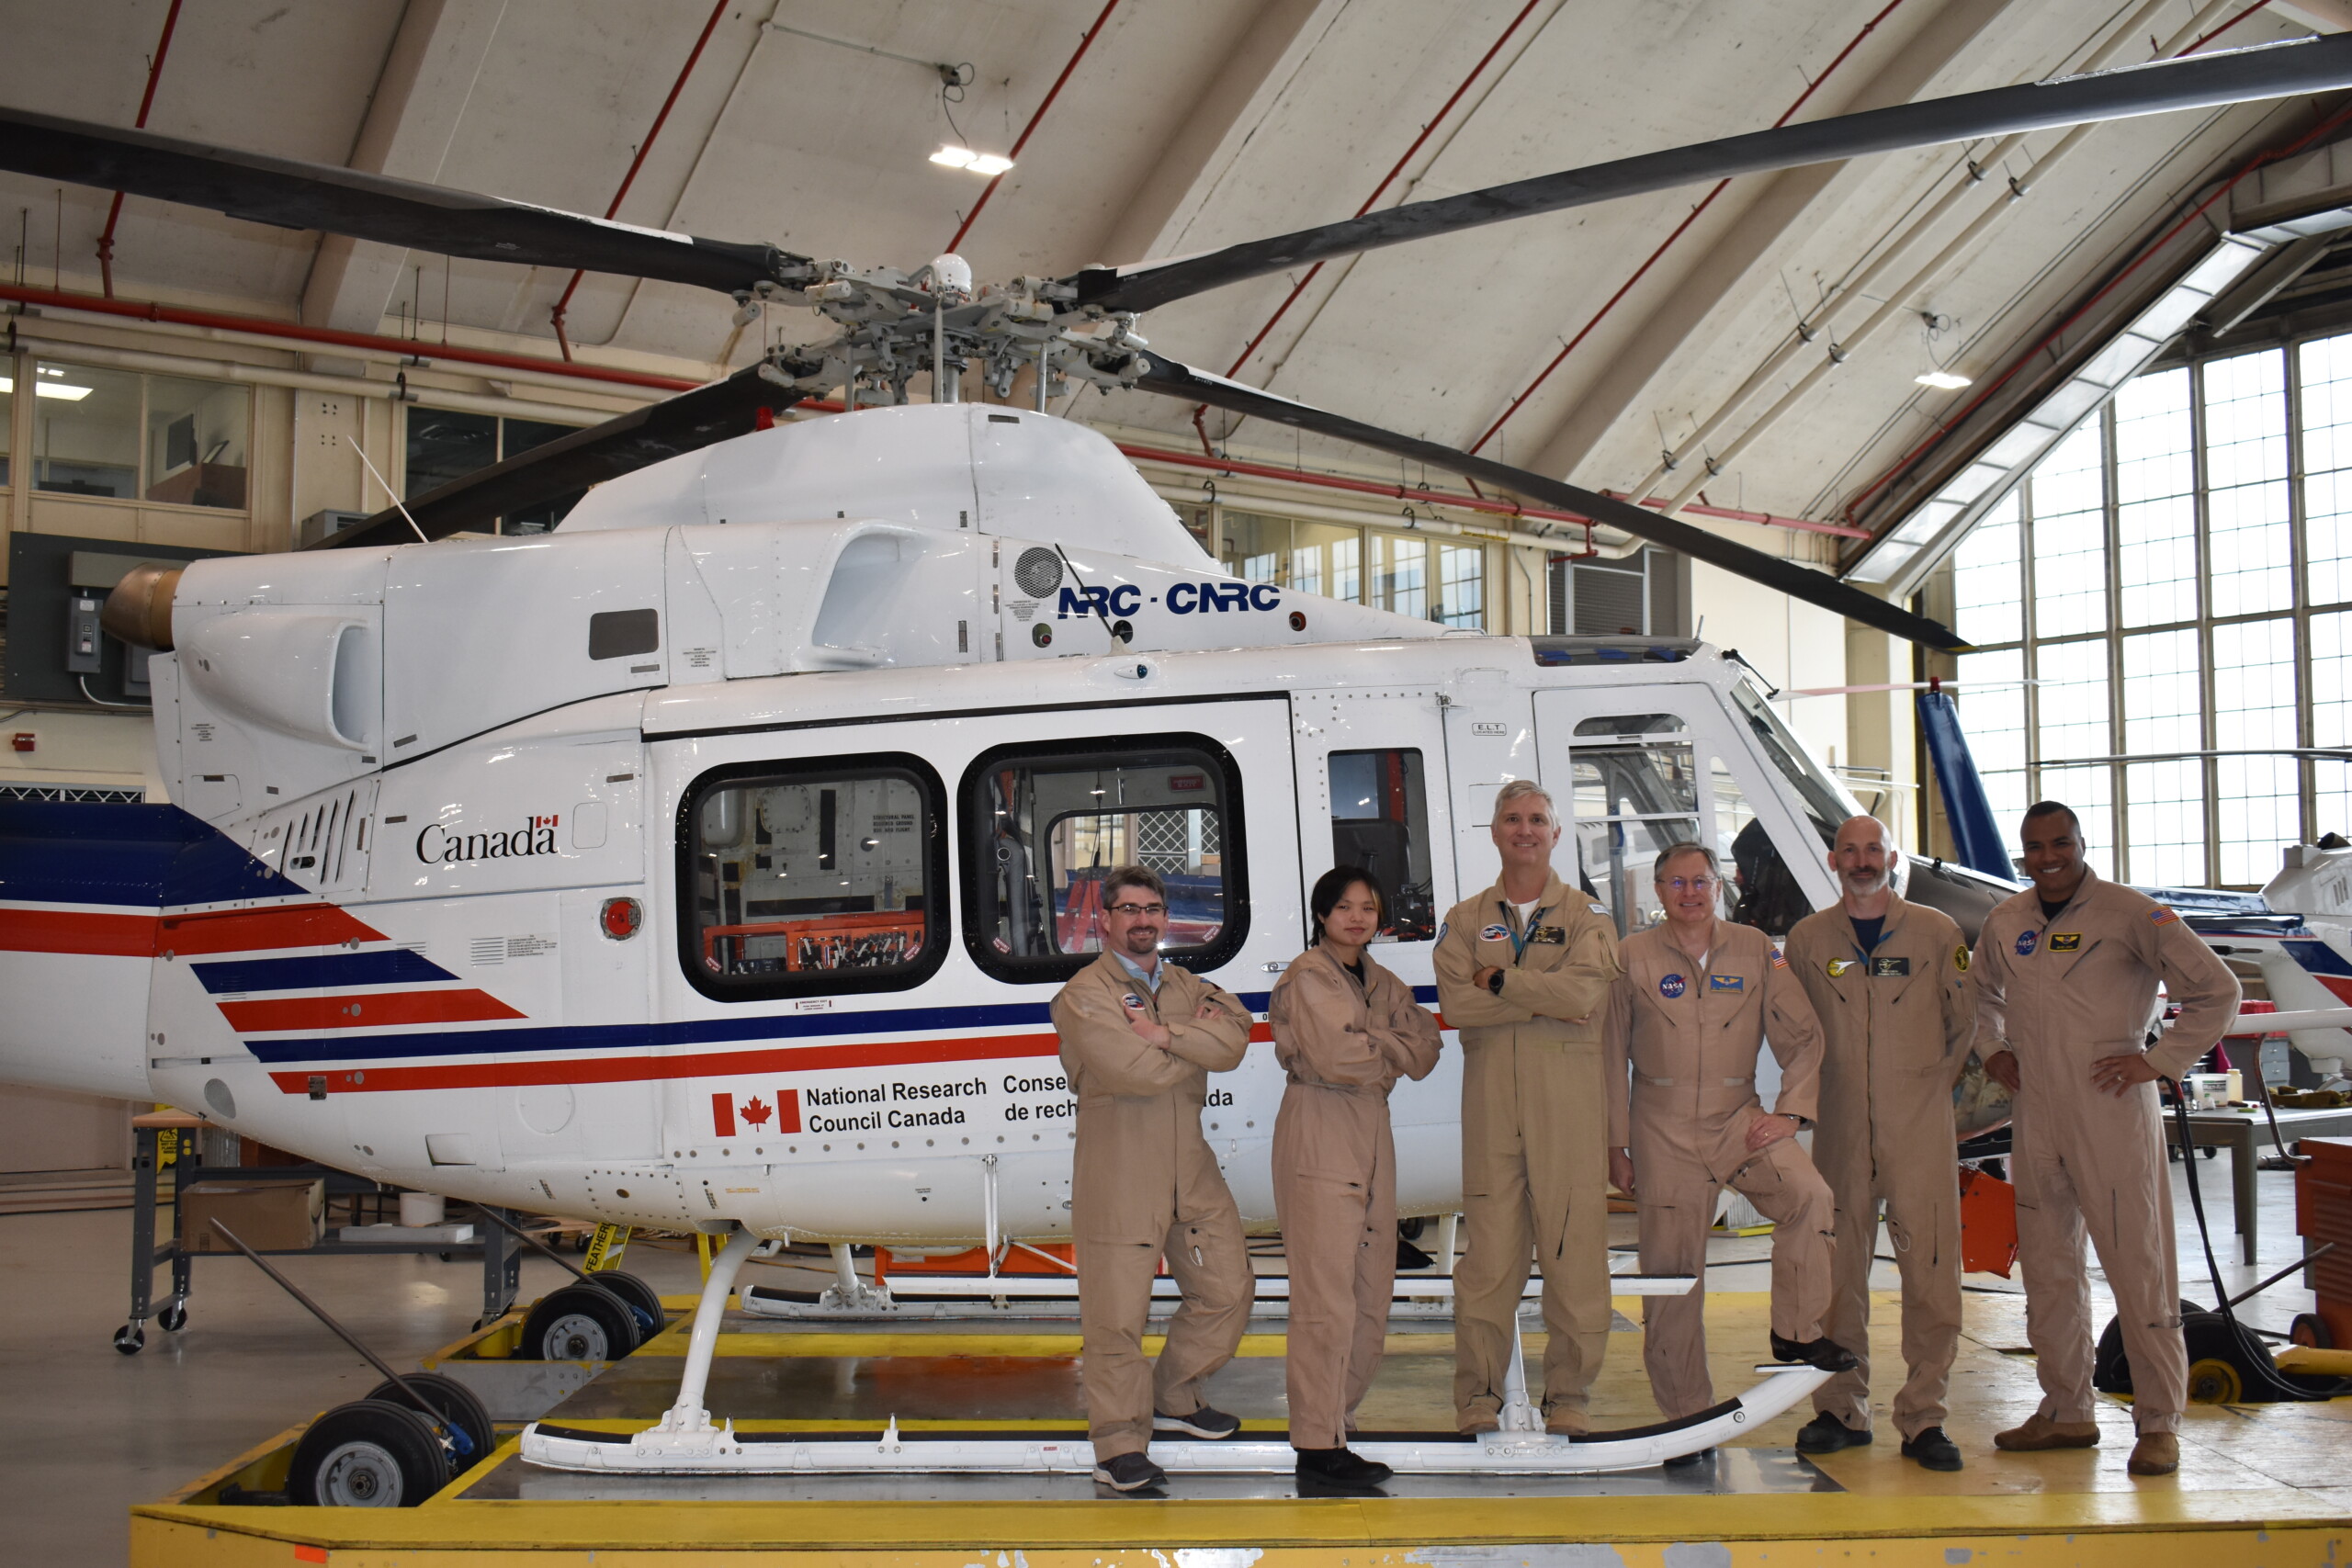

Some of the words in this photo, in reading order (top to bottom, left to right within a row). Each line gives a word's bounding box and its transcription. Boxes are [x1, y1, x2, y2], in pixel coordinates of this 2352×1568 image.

[1057, 584, 1142, 619] NRC
[1166, 582, 1281, 615] CNRC
[416, 816, 559, 864] Canada
[1662, 982, 1683, 990] NASA
[807, 1084, 886, 1106] National
[892, 1077, 987, 1100] Research
[1003, 1075, 1067, 1093] Conse
[1004, 1103, 1028, 1121] de
[1035, 1100, 1078, 1119] rech
[1204, 1089, 1234, 1107] da
[809, 1111, 882, 1133] Council
[888, 1107, 966, 1128] Canada
